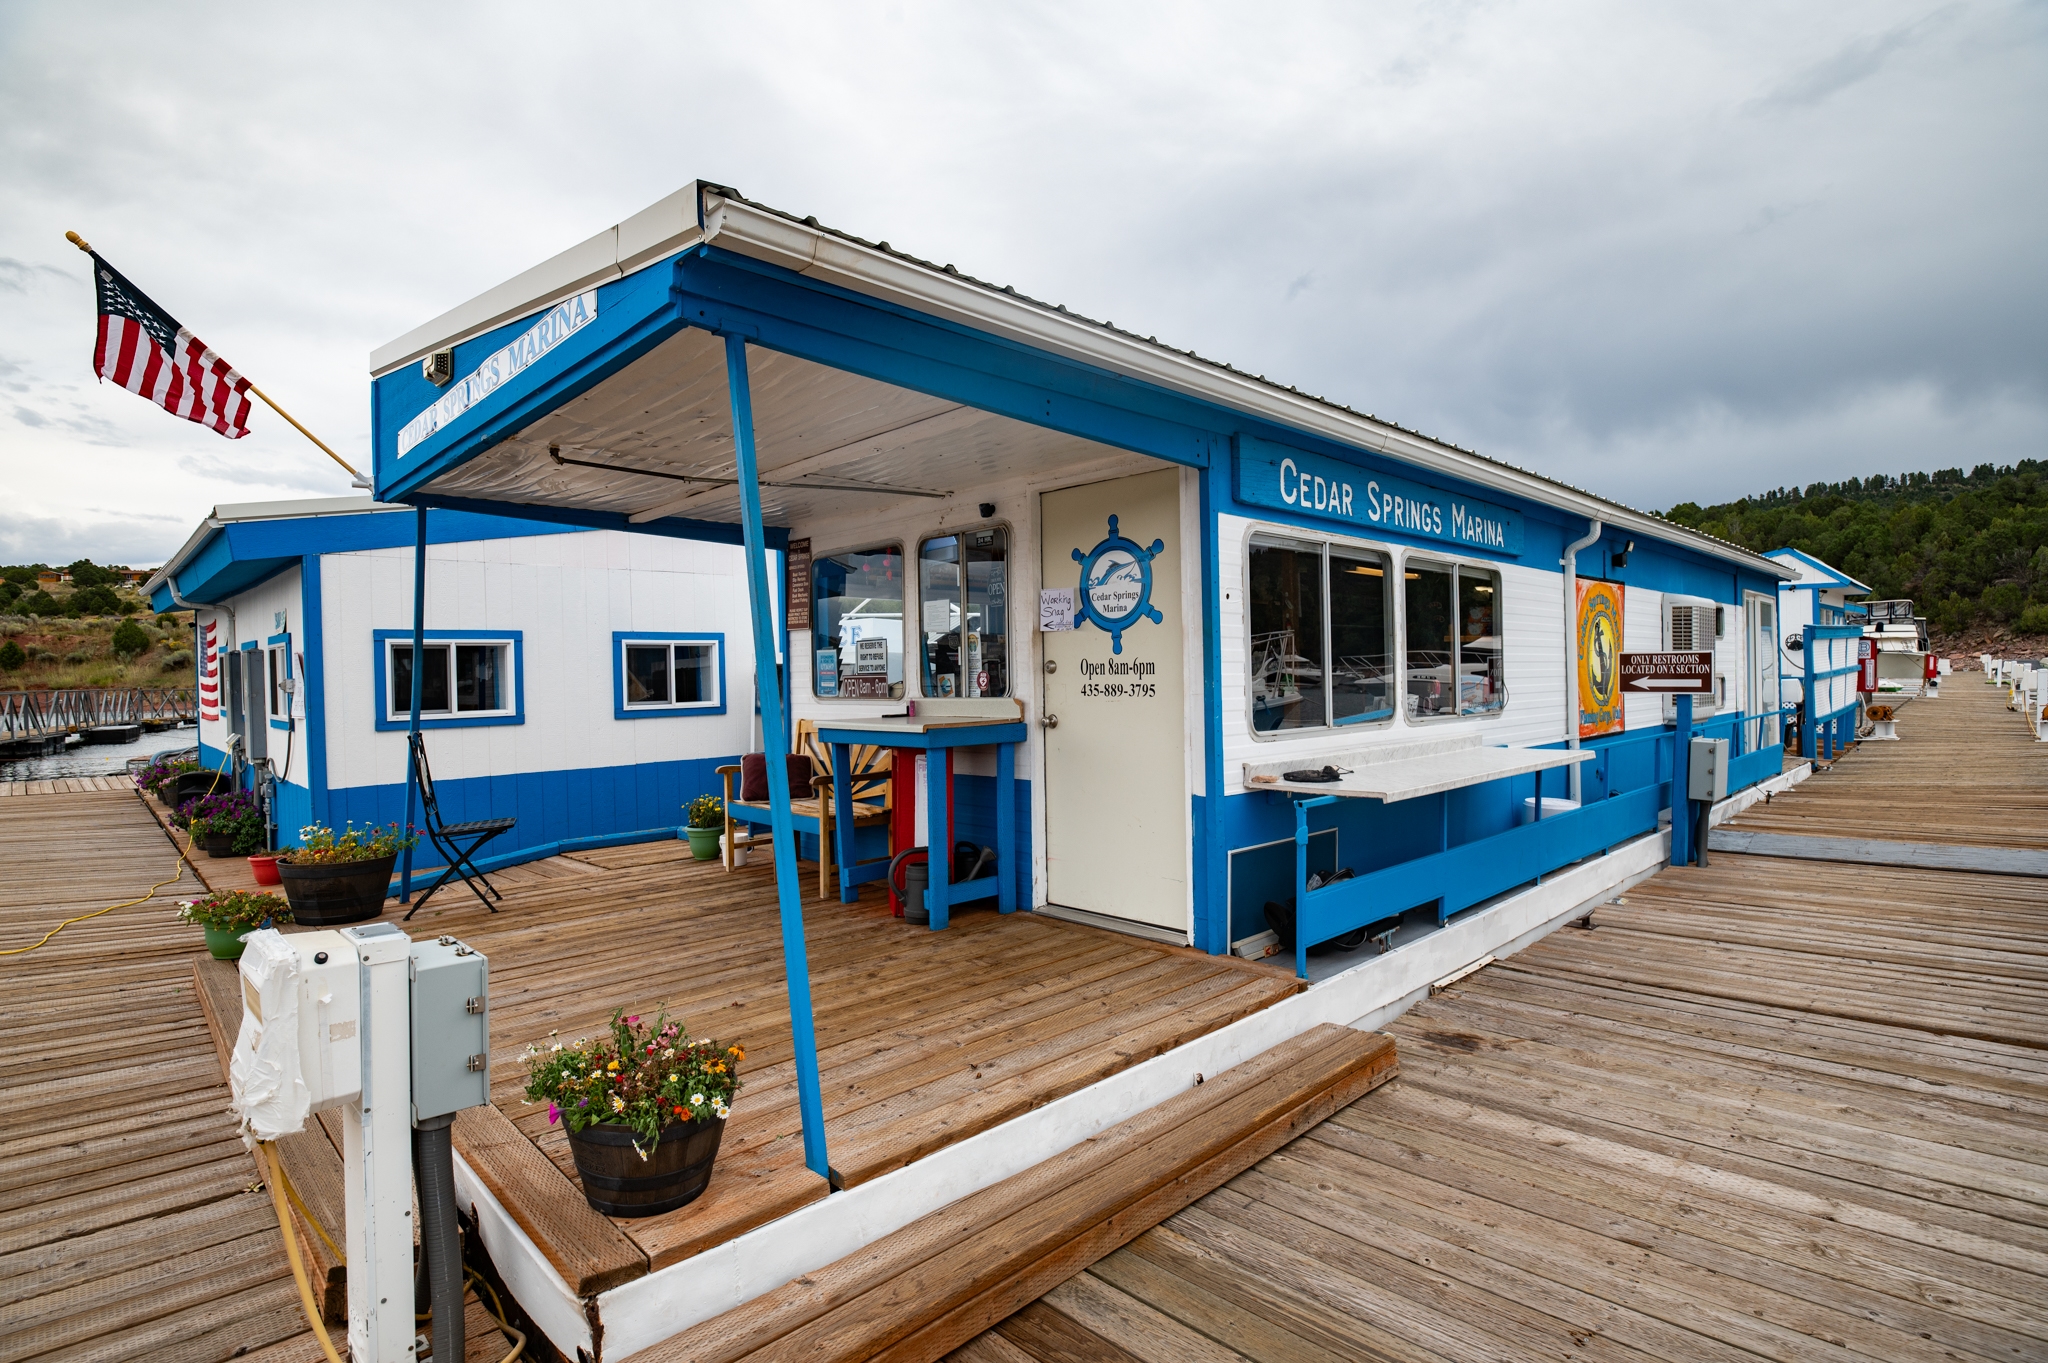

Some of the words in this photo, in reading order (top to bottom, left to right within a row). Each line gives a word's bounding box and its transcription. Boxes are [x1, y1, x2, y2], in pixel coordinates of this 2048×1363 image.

[401, 409, 438, 452] CEDAR
[443, 356, 500, 423] SPRINGS
[508, 294, 589, 376] MARINA
[1279, 457, 1353, 517] CEDAR
[1366, 480, 1442, 535] SPRINGS
[1451, 502, 1505, 548] MARINA
[988, 582, 1005, 596] OPEN
[1091, 591, 1112, 602] Cedar
[1112, 590, 1139, 602] Springs
[1102, 603, 1128, 613] Marina
[1630, 655, 1651, 665] ONLY
[1652, 654, 1700, 664] RESTROOMS
[1080, 658, 1106, 681] Open
[1108, 657, 1156, 681] 8am-6pm
[1621, 664, 1656, 674] LOCATED
[1656, 664, 1668, 674] ON
[1676, 664, 1710, 674] SECTION
[844, 678, 859, 697] OPEN
[860, 678, 871, 694] 8am
[875, 678, 888, 698] 6pm
[1080, 683, 1156, 697] 435-889-3795
